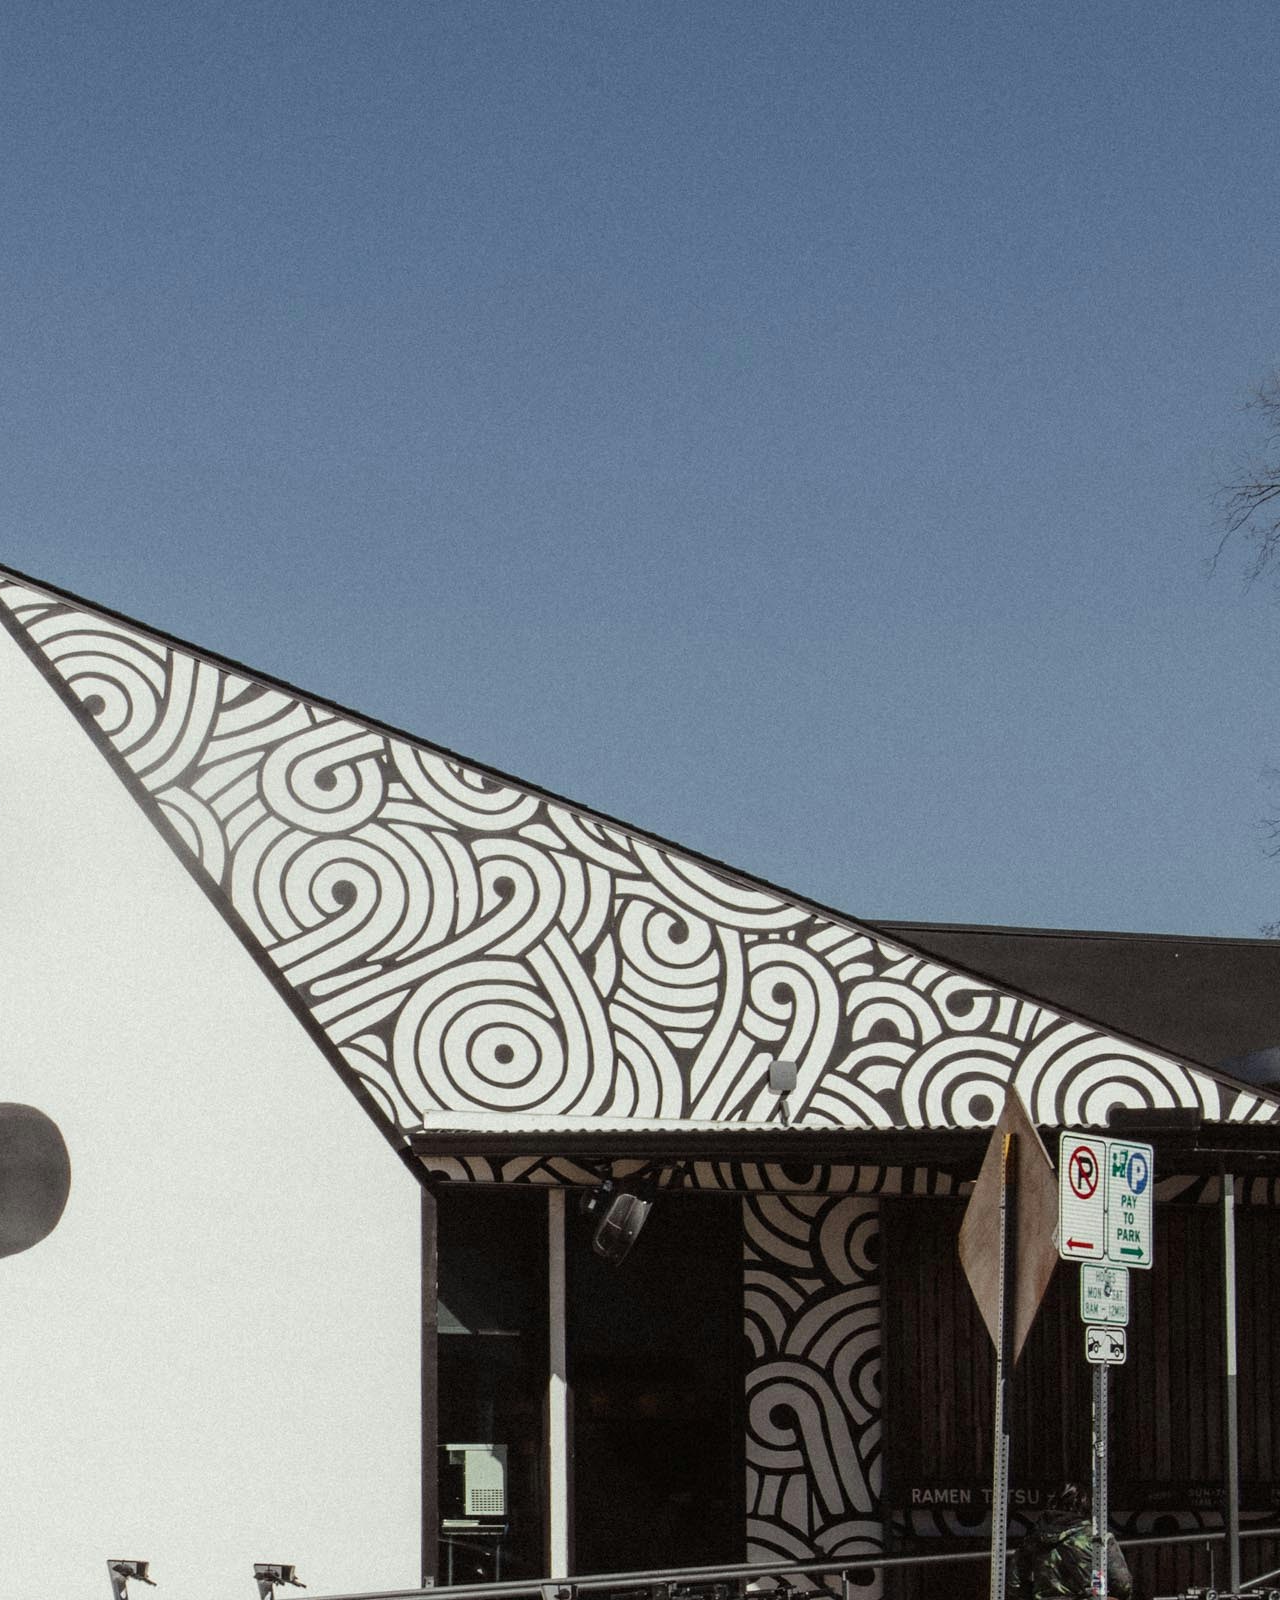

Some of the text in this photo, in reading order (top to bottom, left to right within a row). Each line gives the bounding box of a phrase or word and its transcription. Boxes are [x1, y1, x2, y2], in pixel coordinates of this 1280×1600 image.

[1121, 1195, 1137, 1209] PAY
[1124, 1212, 1135, 1225] TO
[1117, 1228, 1141, 1243] PARK
[1087, 1286, 1101, 1299] MON
[1085, 1302, 1098, 1314] 8AM
[912, 1488, 972, 1504] RAMEN
[981, 1489, 1040, 1504] TTSU
